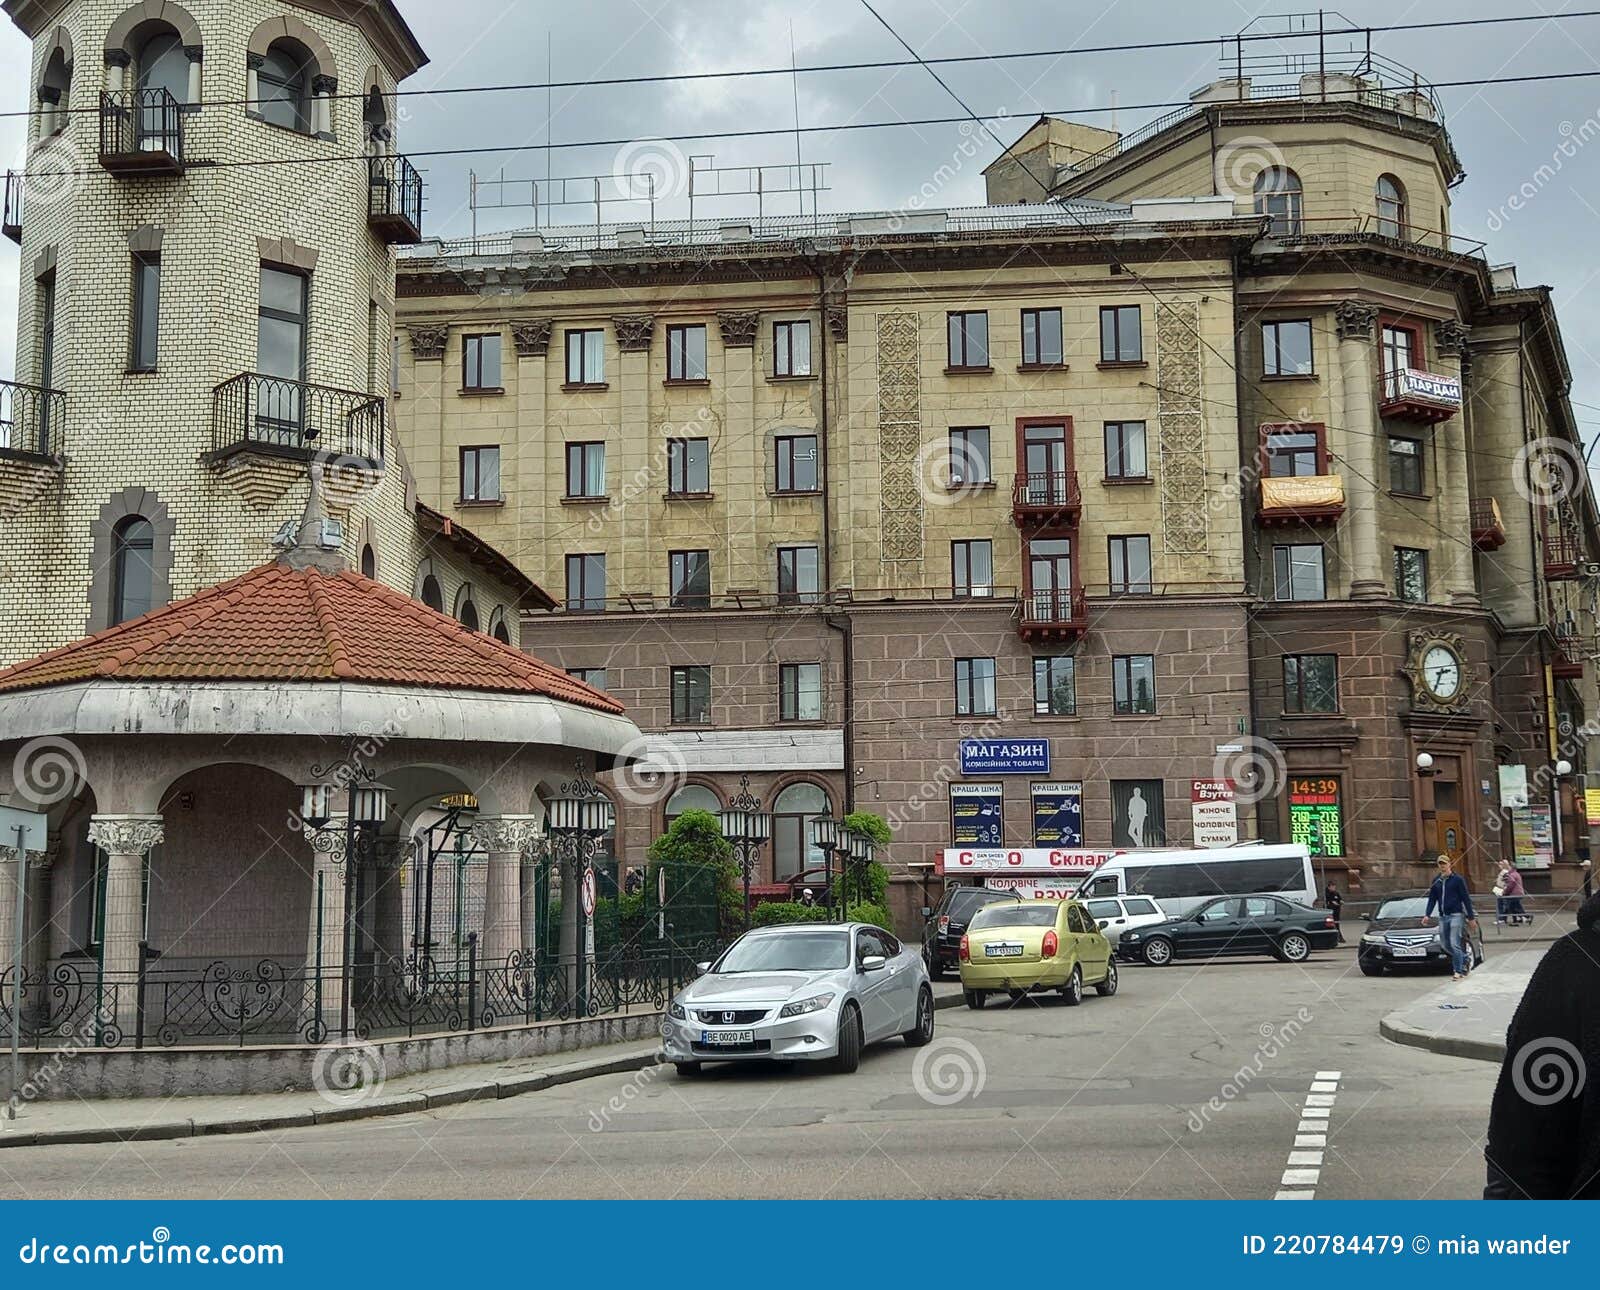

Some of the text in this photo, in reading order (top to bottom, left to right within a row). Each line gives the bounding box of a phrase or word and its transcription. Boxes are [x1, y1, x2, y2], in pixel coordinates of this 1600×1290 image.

[965, 744, 1044, 759] МАГАЗИН
[965, 760, 1011, 768] КОМІСІЙНИХ
[1193, 781, 1225, 791] Склад
[1290, 780, 1337, 794] 14:39
[1199, 790, 1233, 800] Взуття
[1201, 835, 1231, 843] СУМКИ
[989, 879, 1038, 889] ЧОЛОВІЧЕ
[707, 1032, 719, 1042] BE
[719, 1032, 738, 1042] 0020
[739, 1031, 751, 1041] AE
